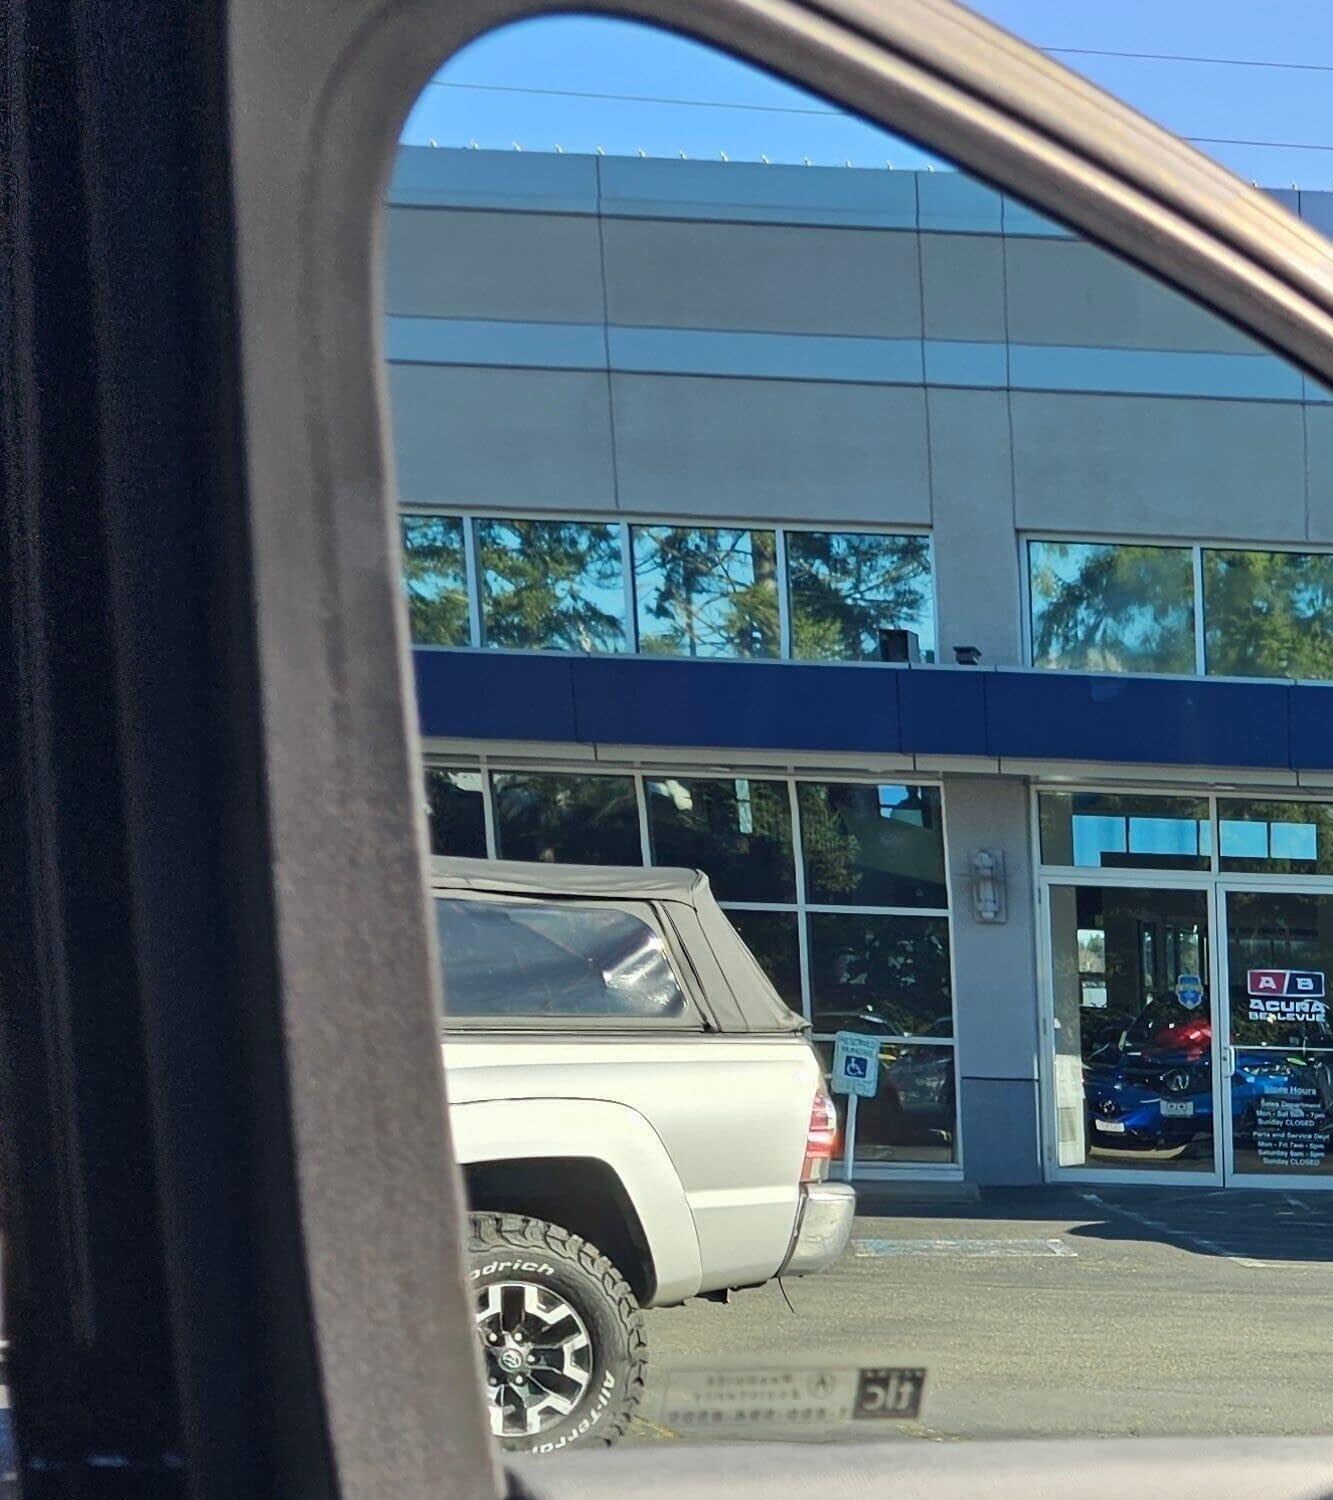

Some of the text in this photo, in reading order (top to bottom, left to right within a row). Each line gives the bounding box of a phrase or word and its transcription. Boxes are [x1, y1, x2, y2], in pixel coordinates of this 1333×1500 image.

[1258, 976, 1314, 990] A B
[1249, 999, 1326, 1013] ACURA
[1290, 1086, 1317, 1096] Hours
[1256, 1109, 1272, 1117] Mon
[1257, 1118, 1315, 1127] Sunday CLOSED
[1257, 1140, 1273, 1148] Mon
[1262, 1157, 1320, 1166] Sunday CLOSED
